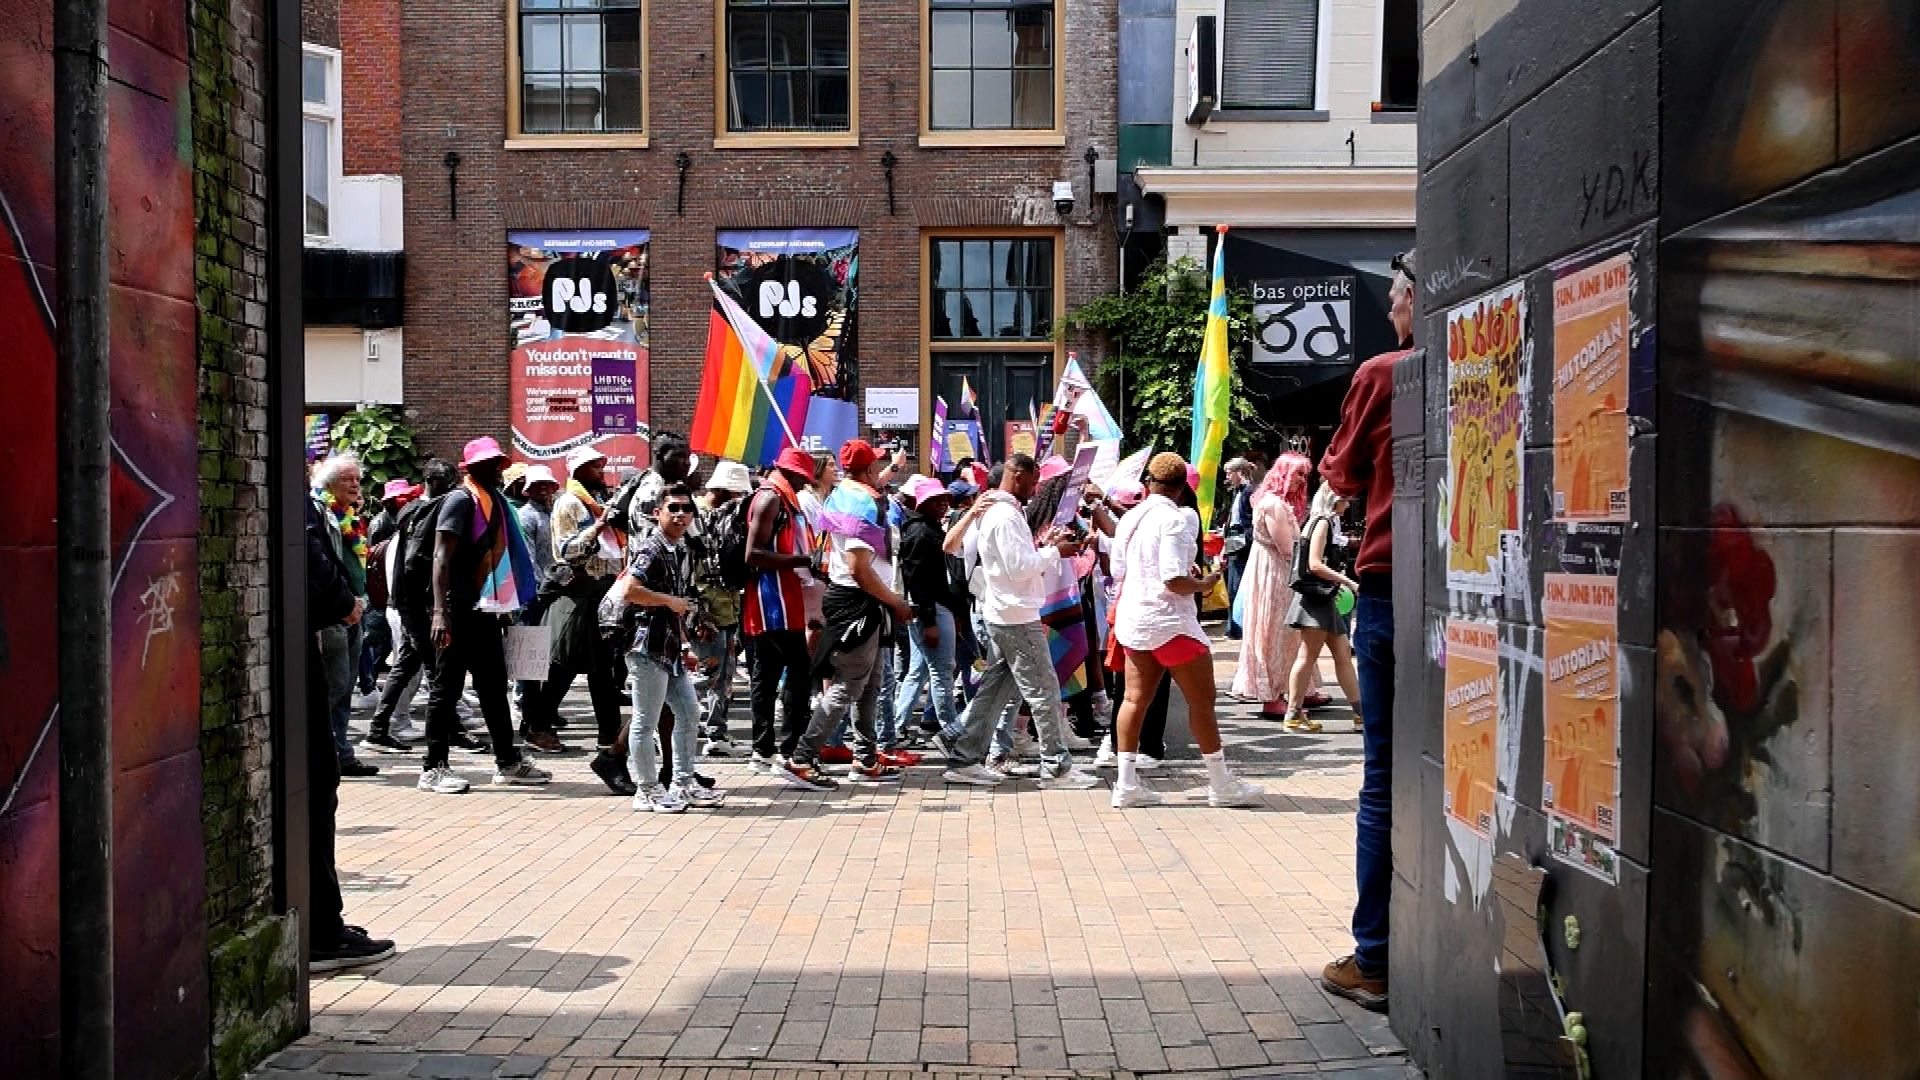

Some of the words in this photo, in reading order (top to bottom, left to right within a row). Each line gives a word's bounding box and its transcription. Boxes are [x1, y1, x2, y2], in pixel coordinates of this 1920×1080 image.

[552, 277, 607, 313] PJs
[759, 280, 817, 318] PJs
[1253, 281, 1286, 299] bas
[1292, 279, 1351, 301] optiek
[1556, 286, 1576, 308] SUN.
[1577, 275, 1601, 301] JUNE
[1603, 265, 1627, 292] 16TH
[526, 349, 551, 362] You
[552, 348, 587, 361] don't
[622, 349, 637, 361] to
[1556, 316, 1624, 391] HISTORIAN
[525, 364, 557, 376] miss
[558, 364, 581, 376] out
[594, 375, 632, 387] LHBTIQ+
[1547, 583, 1566, 602] SUN.
[1568, 584, 1590, 605] JUNE
[1592, 585, 1615, 607] 16TH
[1463, 630, 1479, 646] JUNE
[1480, 632, 1497, 650] 16TH
[1549, 636, 1611, 682] HISTORIAN
[1448, 674, 1494, 711] HISTORIAN
